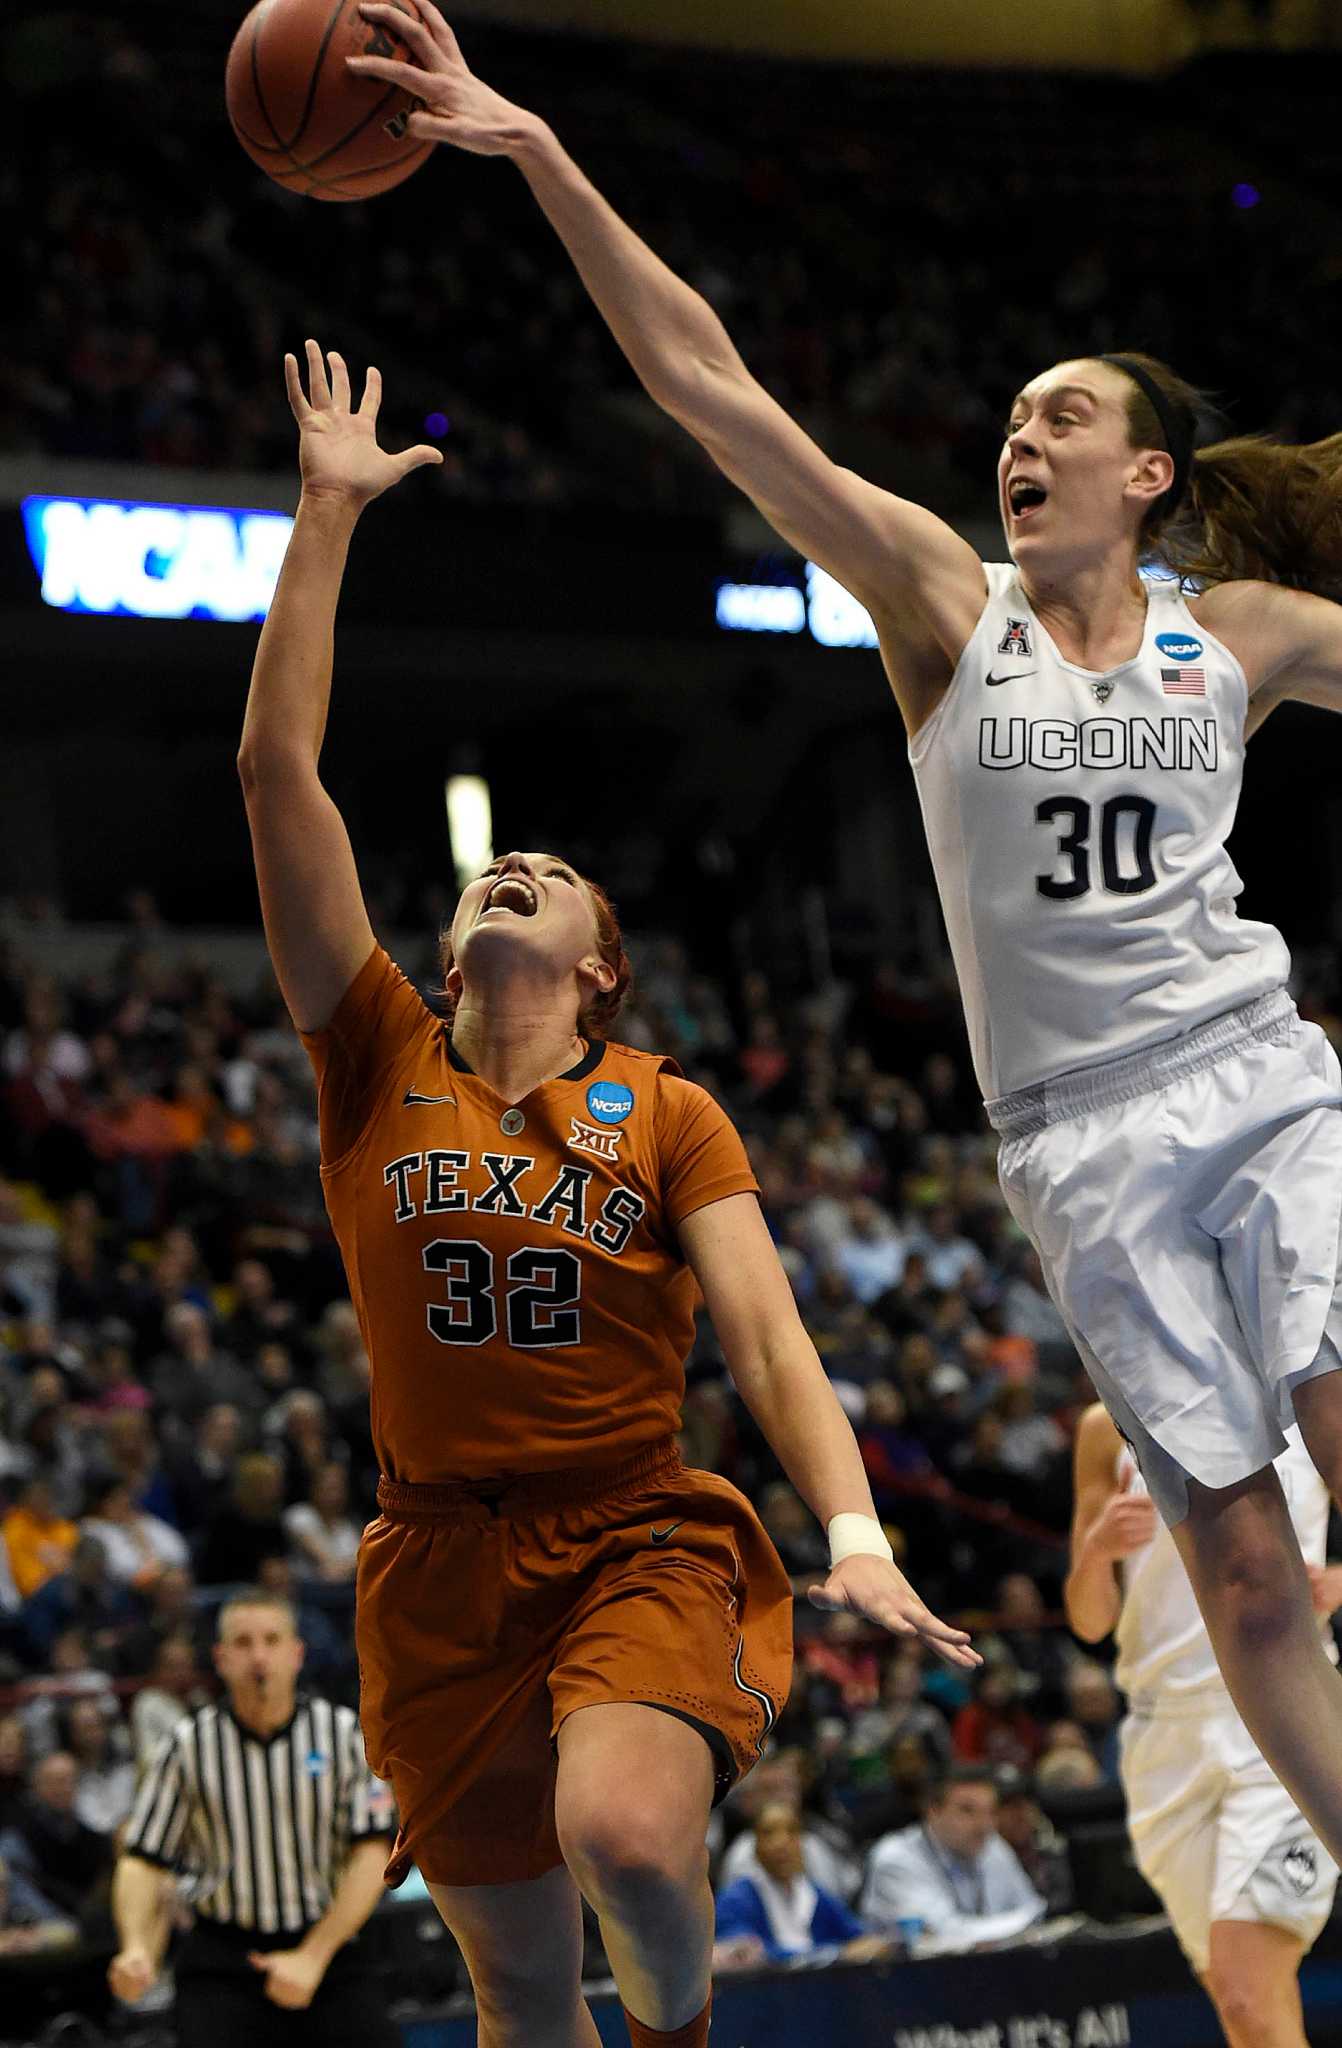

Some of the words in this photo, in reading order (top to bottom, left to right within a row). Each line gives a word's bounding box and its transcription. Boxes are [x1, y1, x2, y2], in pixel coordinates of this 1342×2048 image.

[1162, 643, 1202, 655] NCAA
[979, 717, 1218, 771] UCONN
[1035, 795, 1158, 900] 30
[591, 1097, 632, 1114] NCAA
[384, 1149, 645, 1255] TEXAS
[422, 1239, 581, 1347] 32
